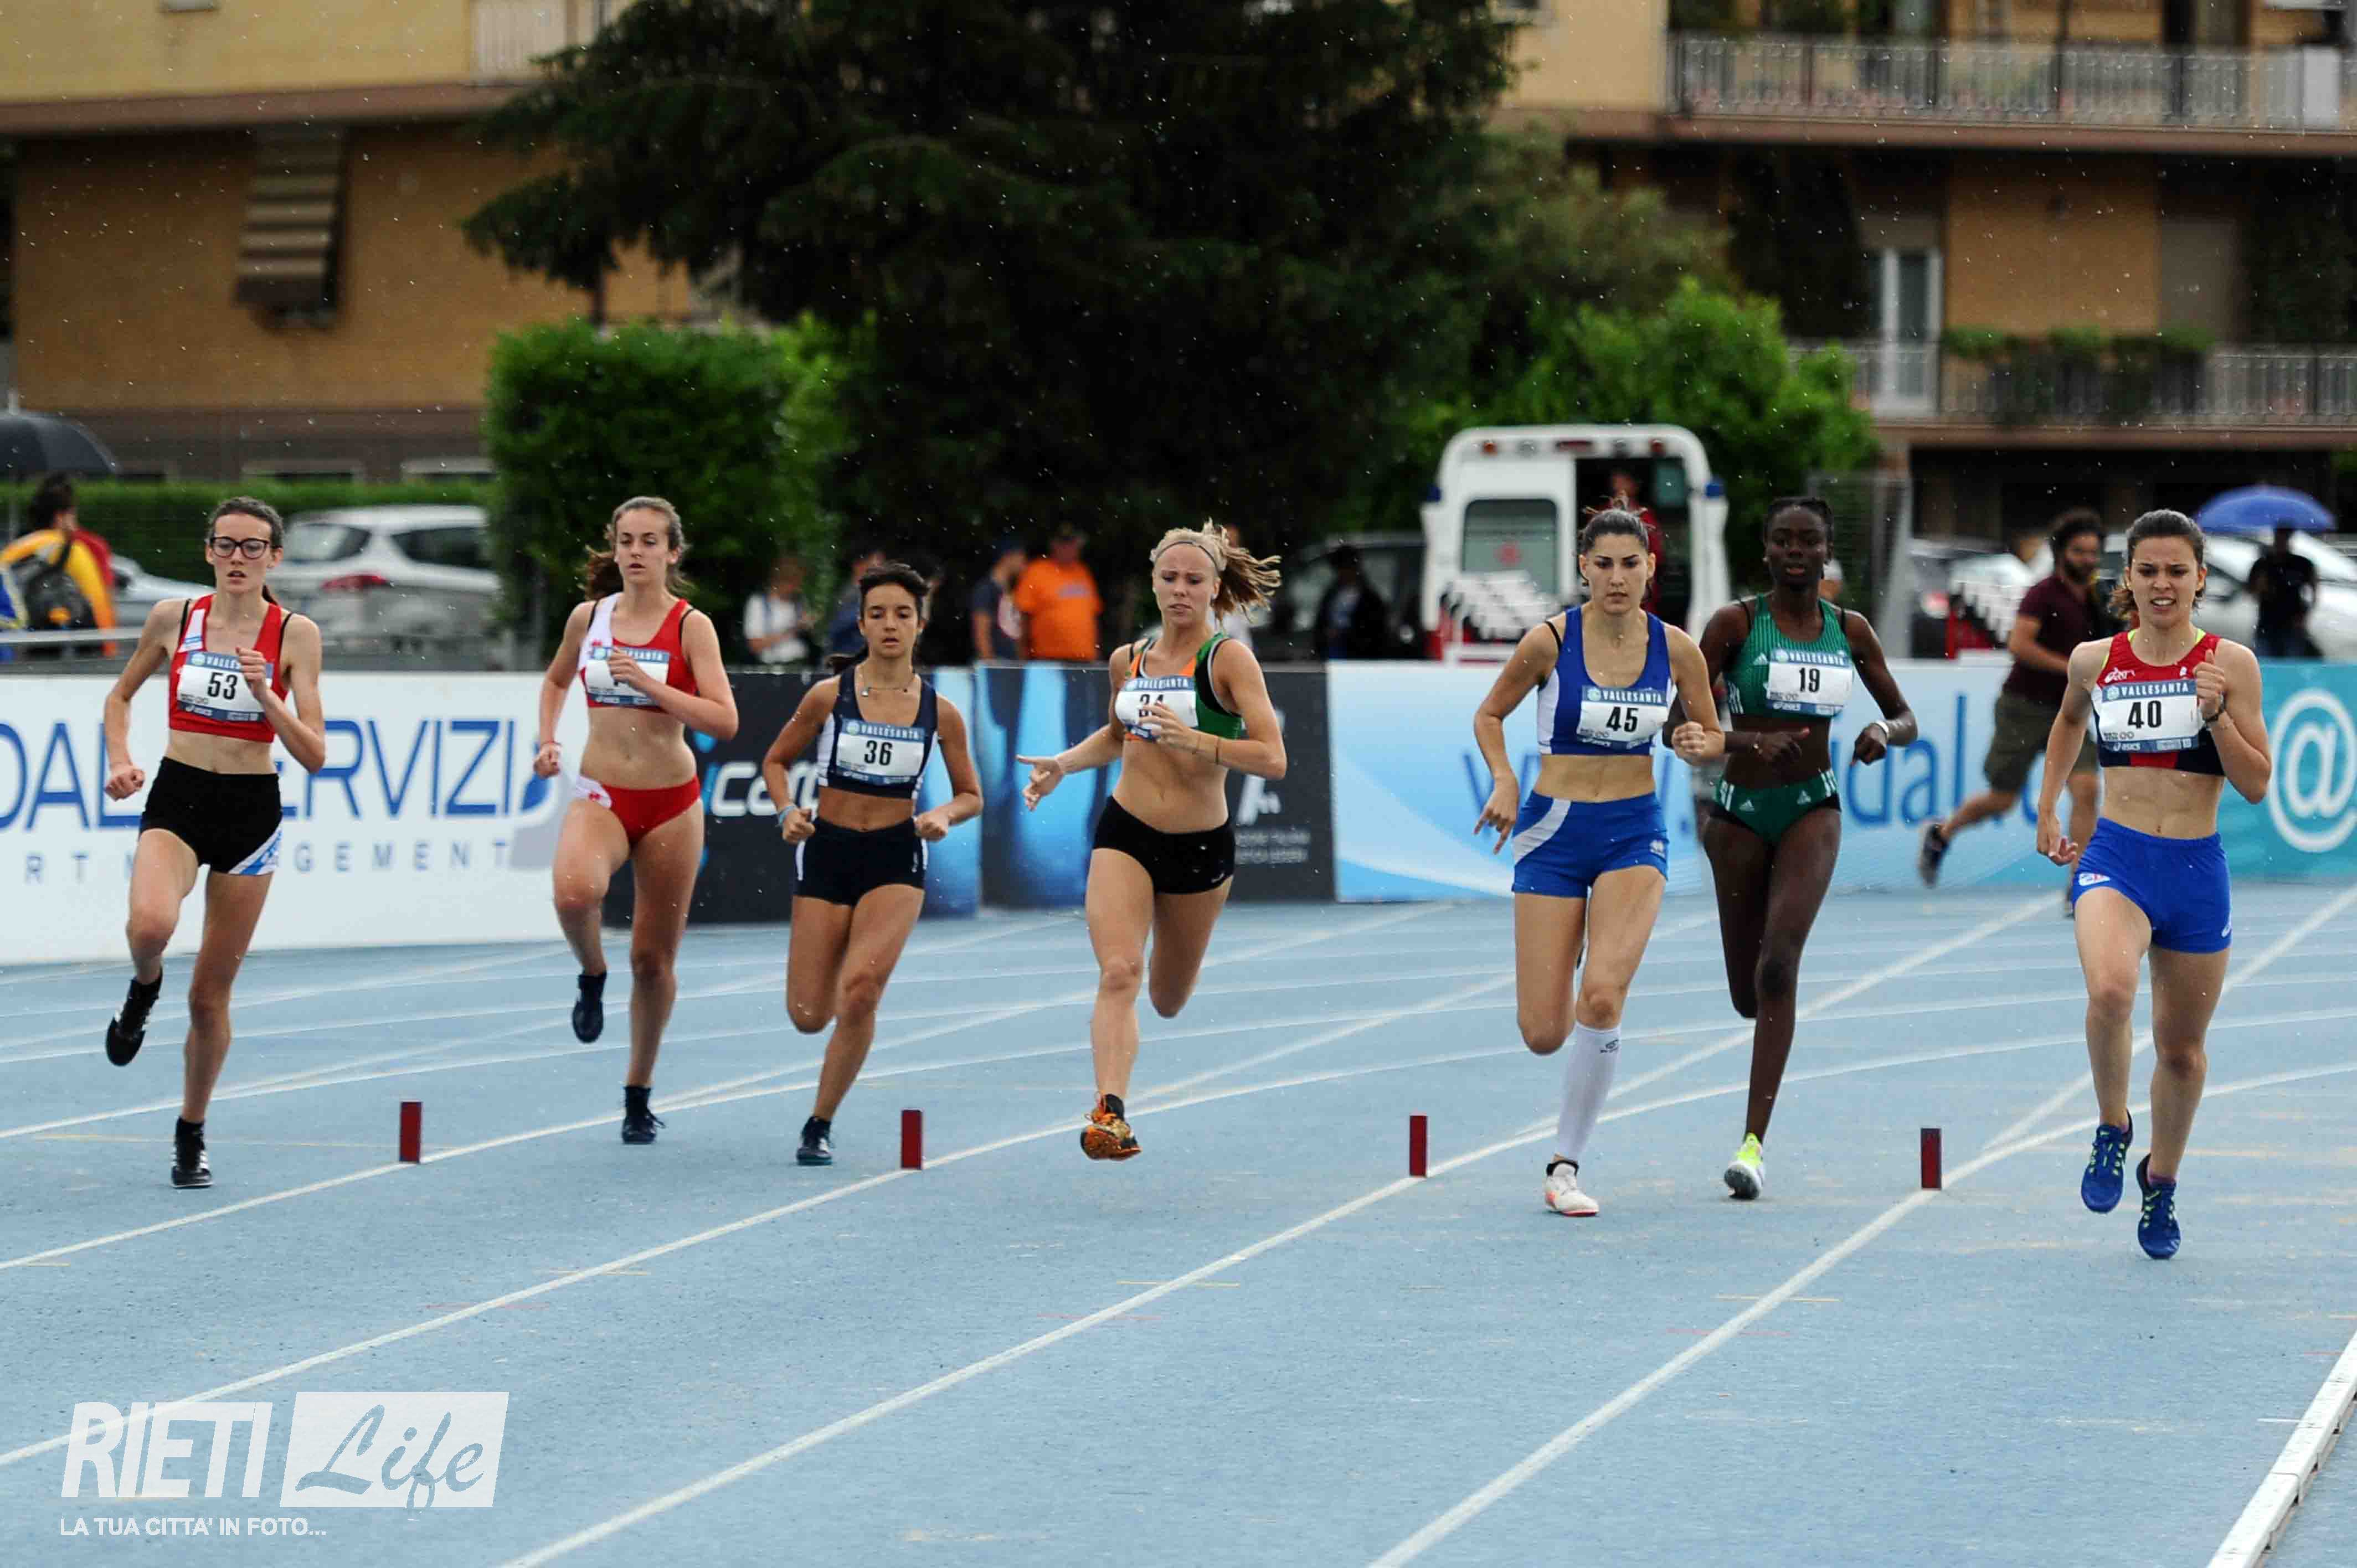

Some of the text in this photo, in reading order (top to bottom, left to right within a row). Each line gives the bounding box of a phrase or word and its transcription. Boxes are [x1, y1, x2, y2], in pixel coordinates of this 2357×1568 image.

[207, 672, 238, 700] 53
[1799, 667, 1820, 693] 19
[2122, 682, 2189, 696] VALLESANTA
[1603, 690, 1662, 703] VALLESANTA
[1607, 706, 1639, 733] 45
[2127, 700, 2162, 729] 40
[861, 724, 918, 739] VALLESANTA
[864, 740, 893, 766] 36
